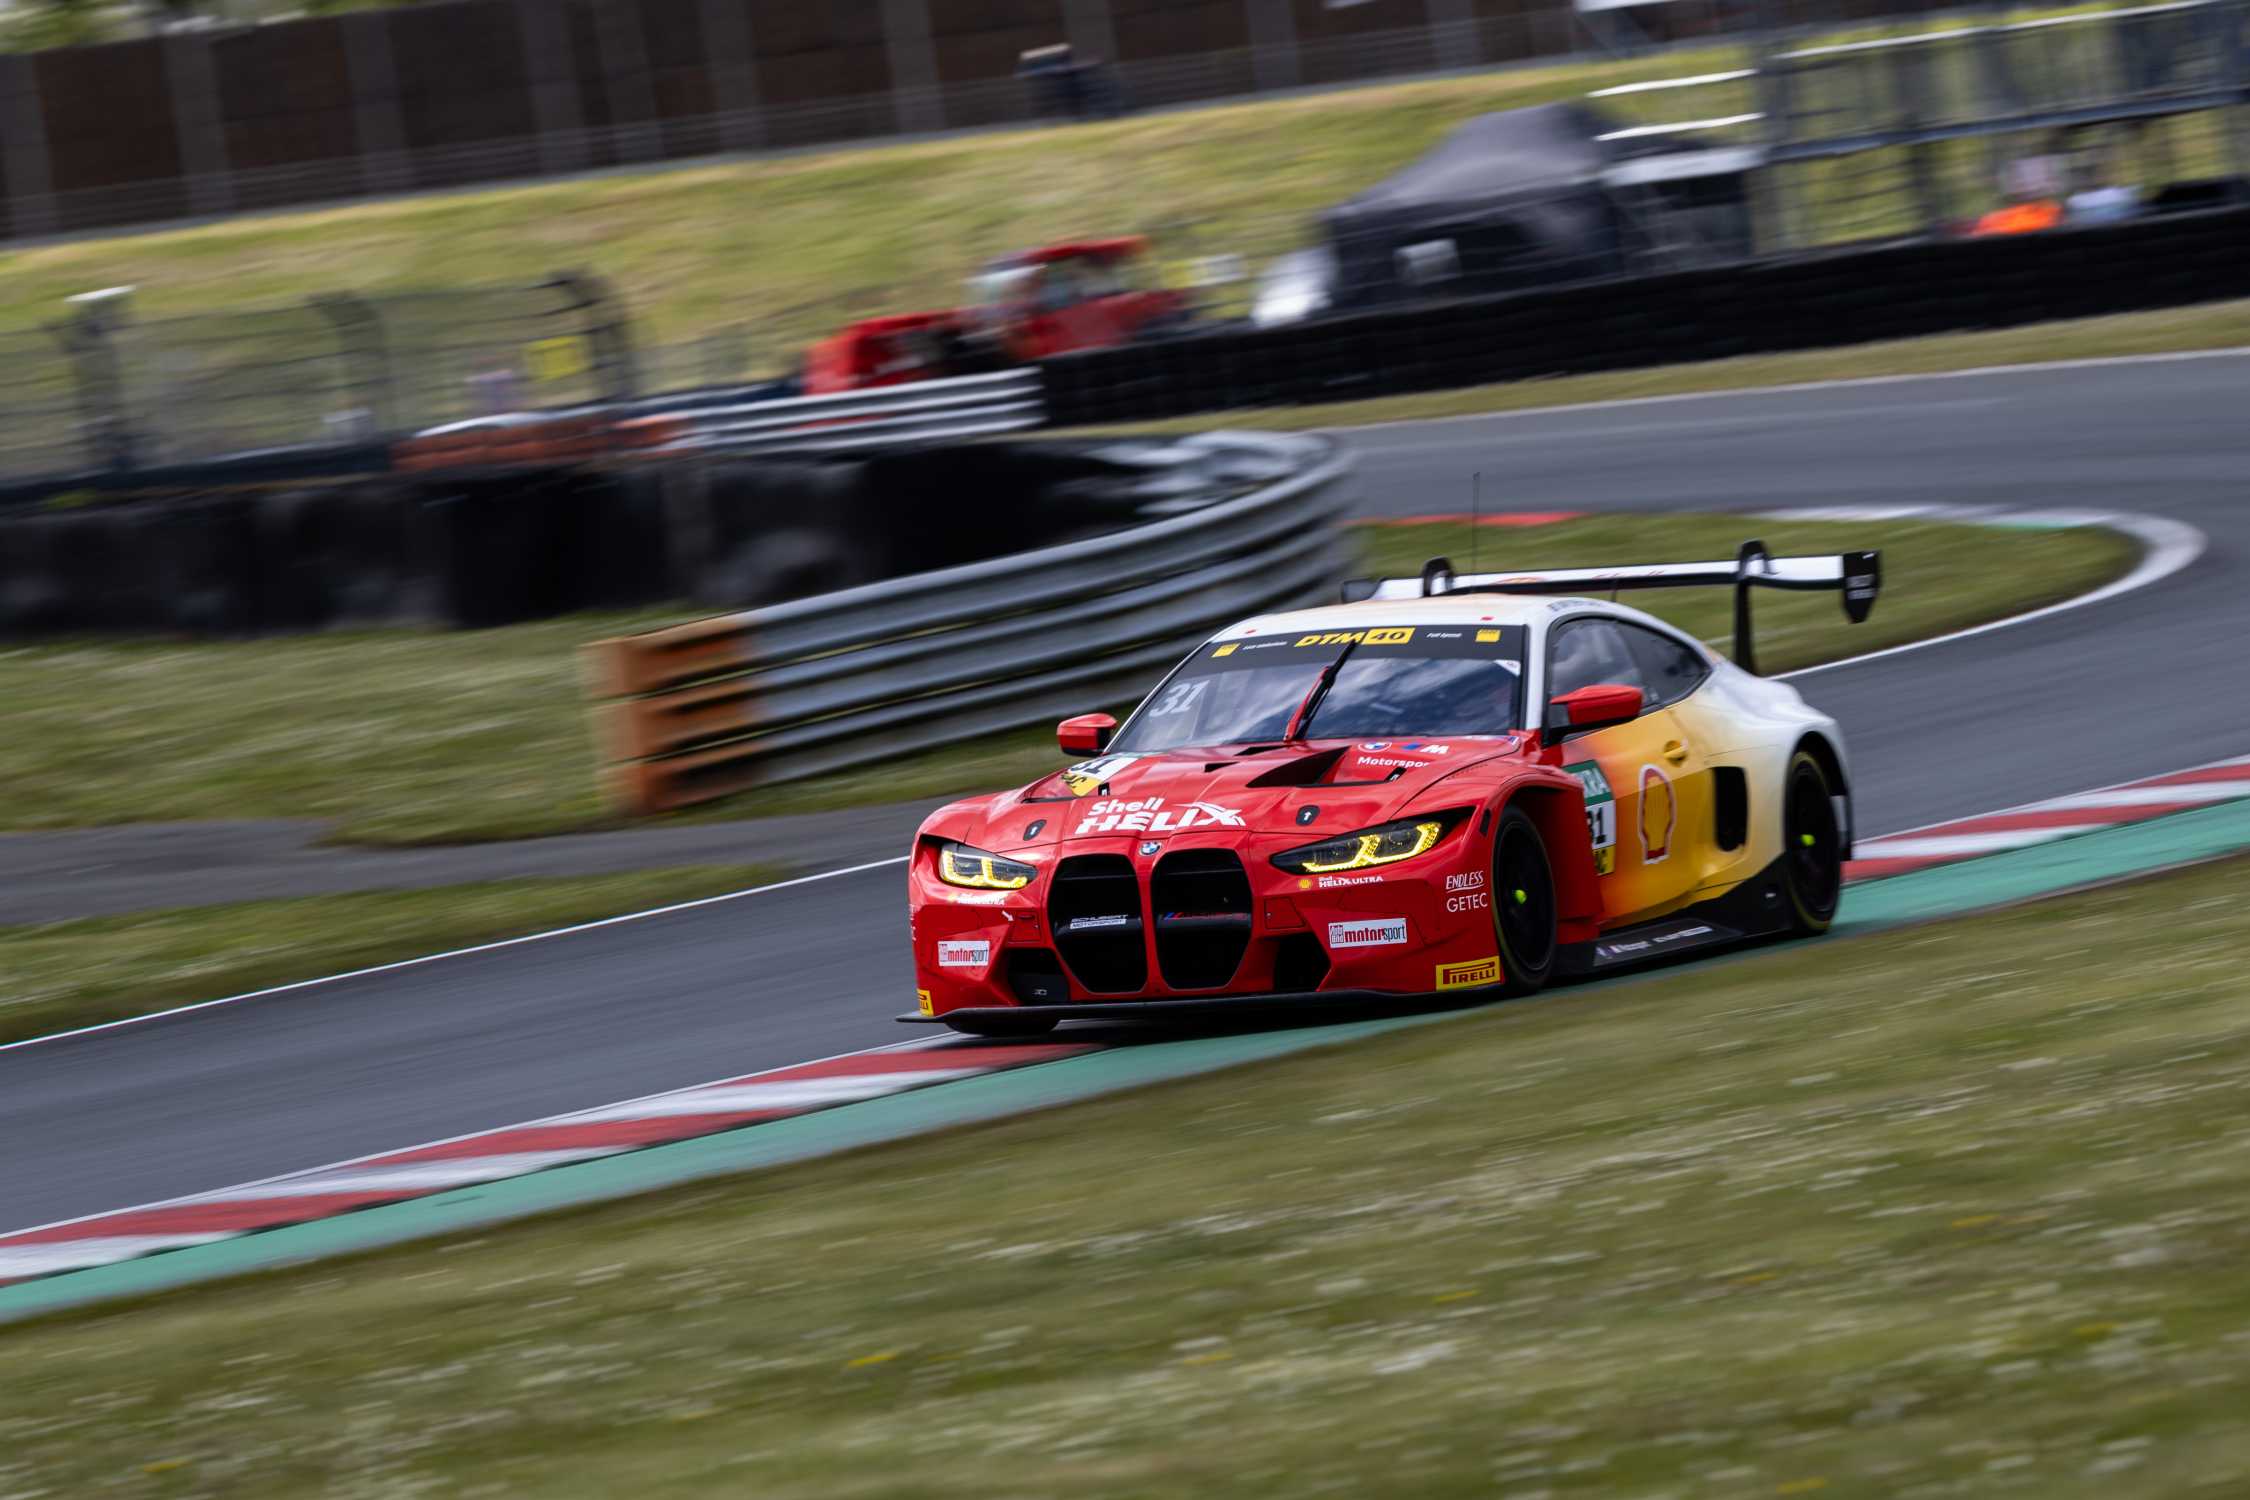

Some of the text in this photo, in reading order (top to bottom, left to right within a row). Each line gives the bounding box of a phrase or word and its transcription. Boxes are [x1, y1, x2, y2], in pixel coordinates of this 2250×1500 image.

[1149, 680, 1210, 717] 31
[1088, 797, 1164, 816] Shell
[1075, 802, 1246, 834] HELIX
[1446, 871, 1484, 891] ENDLESS
[1446, 892, 1488, 912] GETEC
[1345, 924, 1405, 942] motorsport
[948, 948, 988, 963] motorsport
[1442, 962, 1496, 985] PIRELLI
